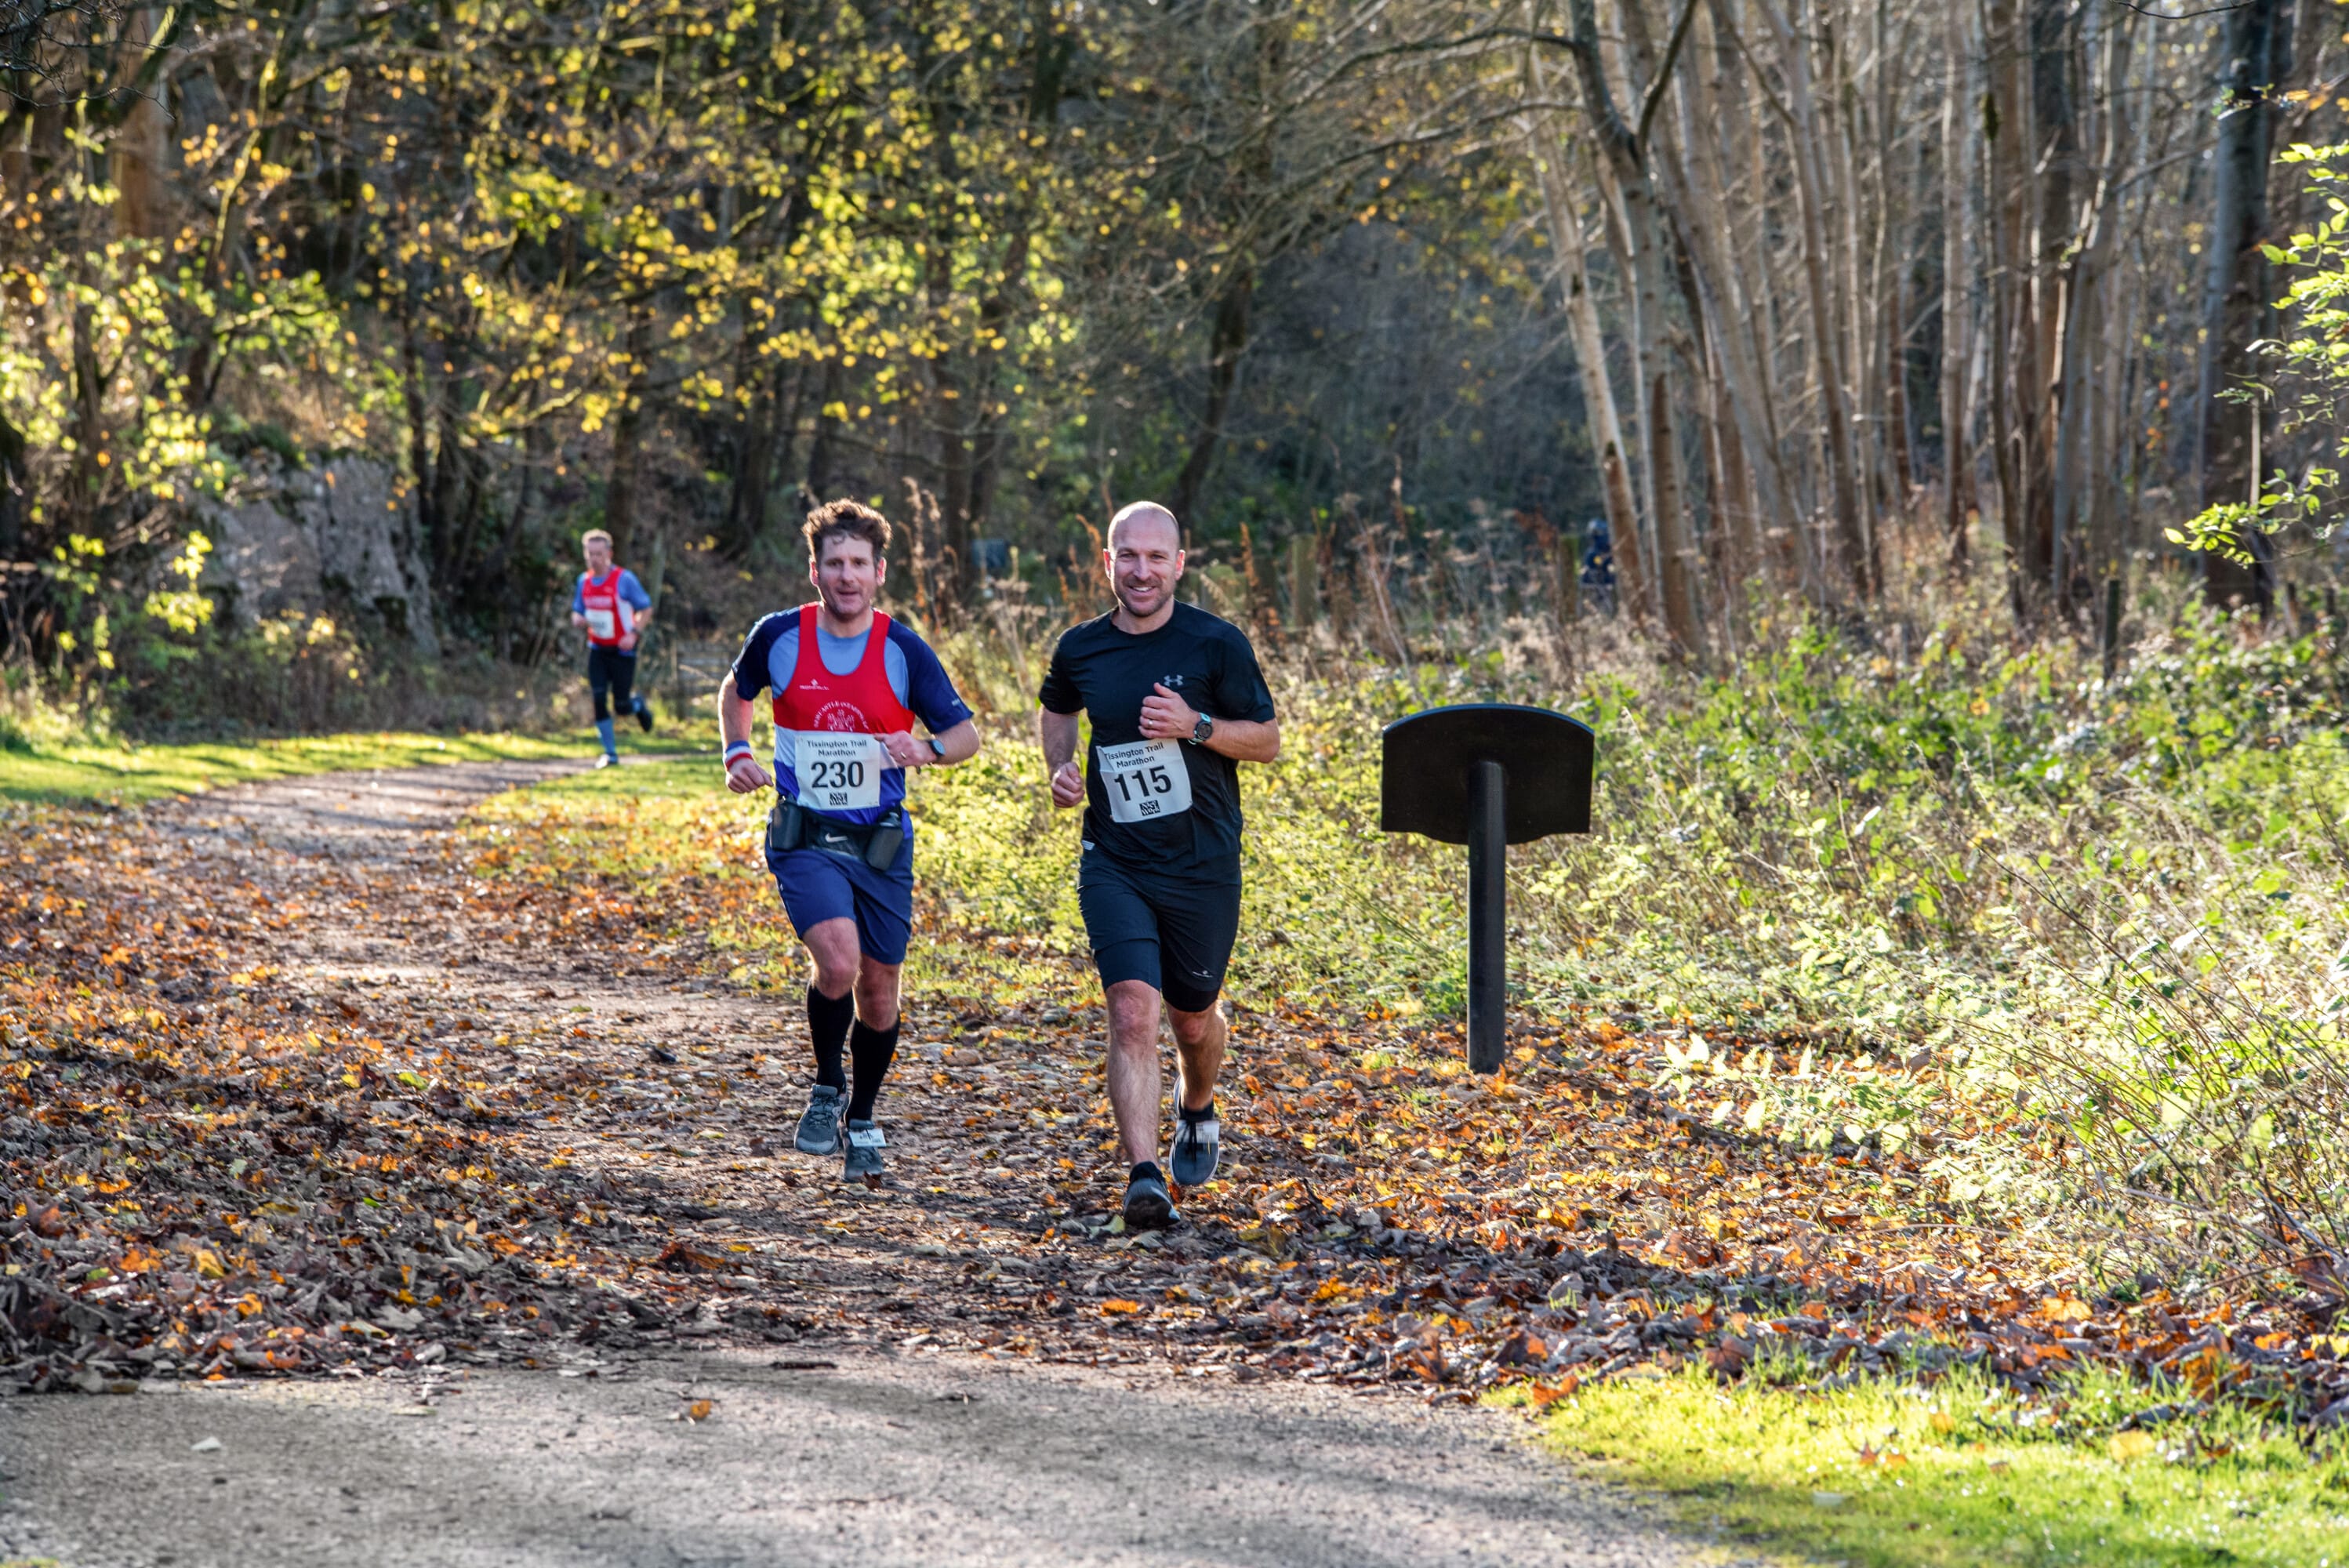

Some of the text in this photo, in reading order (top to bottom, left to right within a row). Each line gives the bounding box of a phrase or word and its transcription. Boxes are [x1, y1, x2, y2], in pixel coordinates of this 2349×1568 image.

[807, 739, 867, 749] Tissington Trail
[1145, 742, 1164, 753] Trail
[818, 749, 856, 757] Marathon
[1116, 755, 1155, 768] Marathon
[811, 760, 864, 789] 230
[1114, 764, 1172, 802] 115
